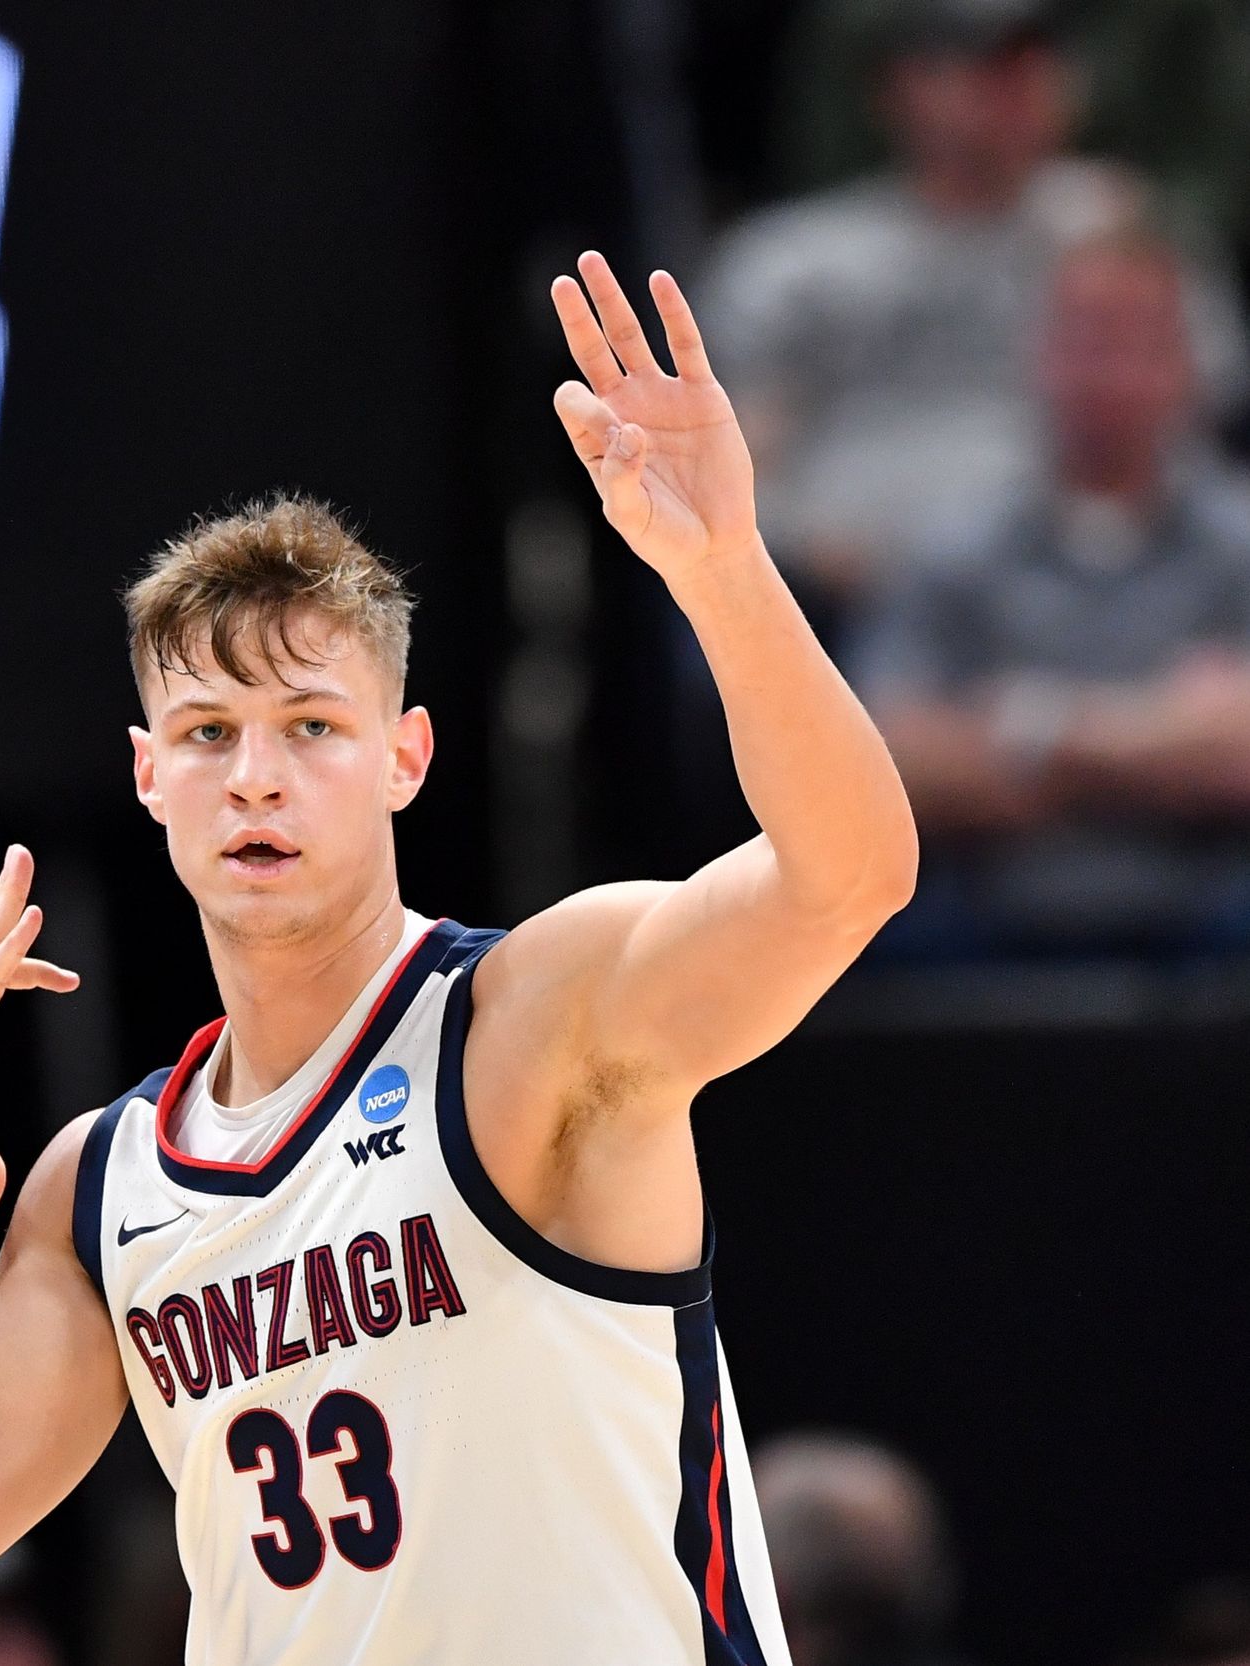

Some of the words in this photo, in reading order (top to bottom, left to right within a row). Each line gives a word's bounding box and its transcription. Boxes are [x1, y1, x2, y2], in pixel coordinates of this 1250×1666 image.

[343, 1123, 406, 1169] WCC
[365, 1086, 406, 1112] NCAA
[126, 1213, 467, 1408] GONZAGA
[226, 1389, 402, 1590] 33
